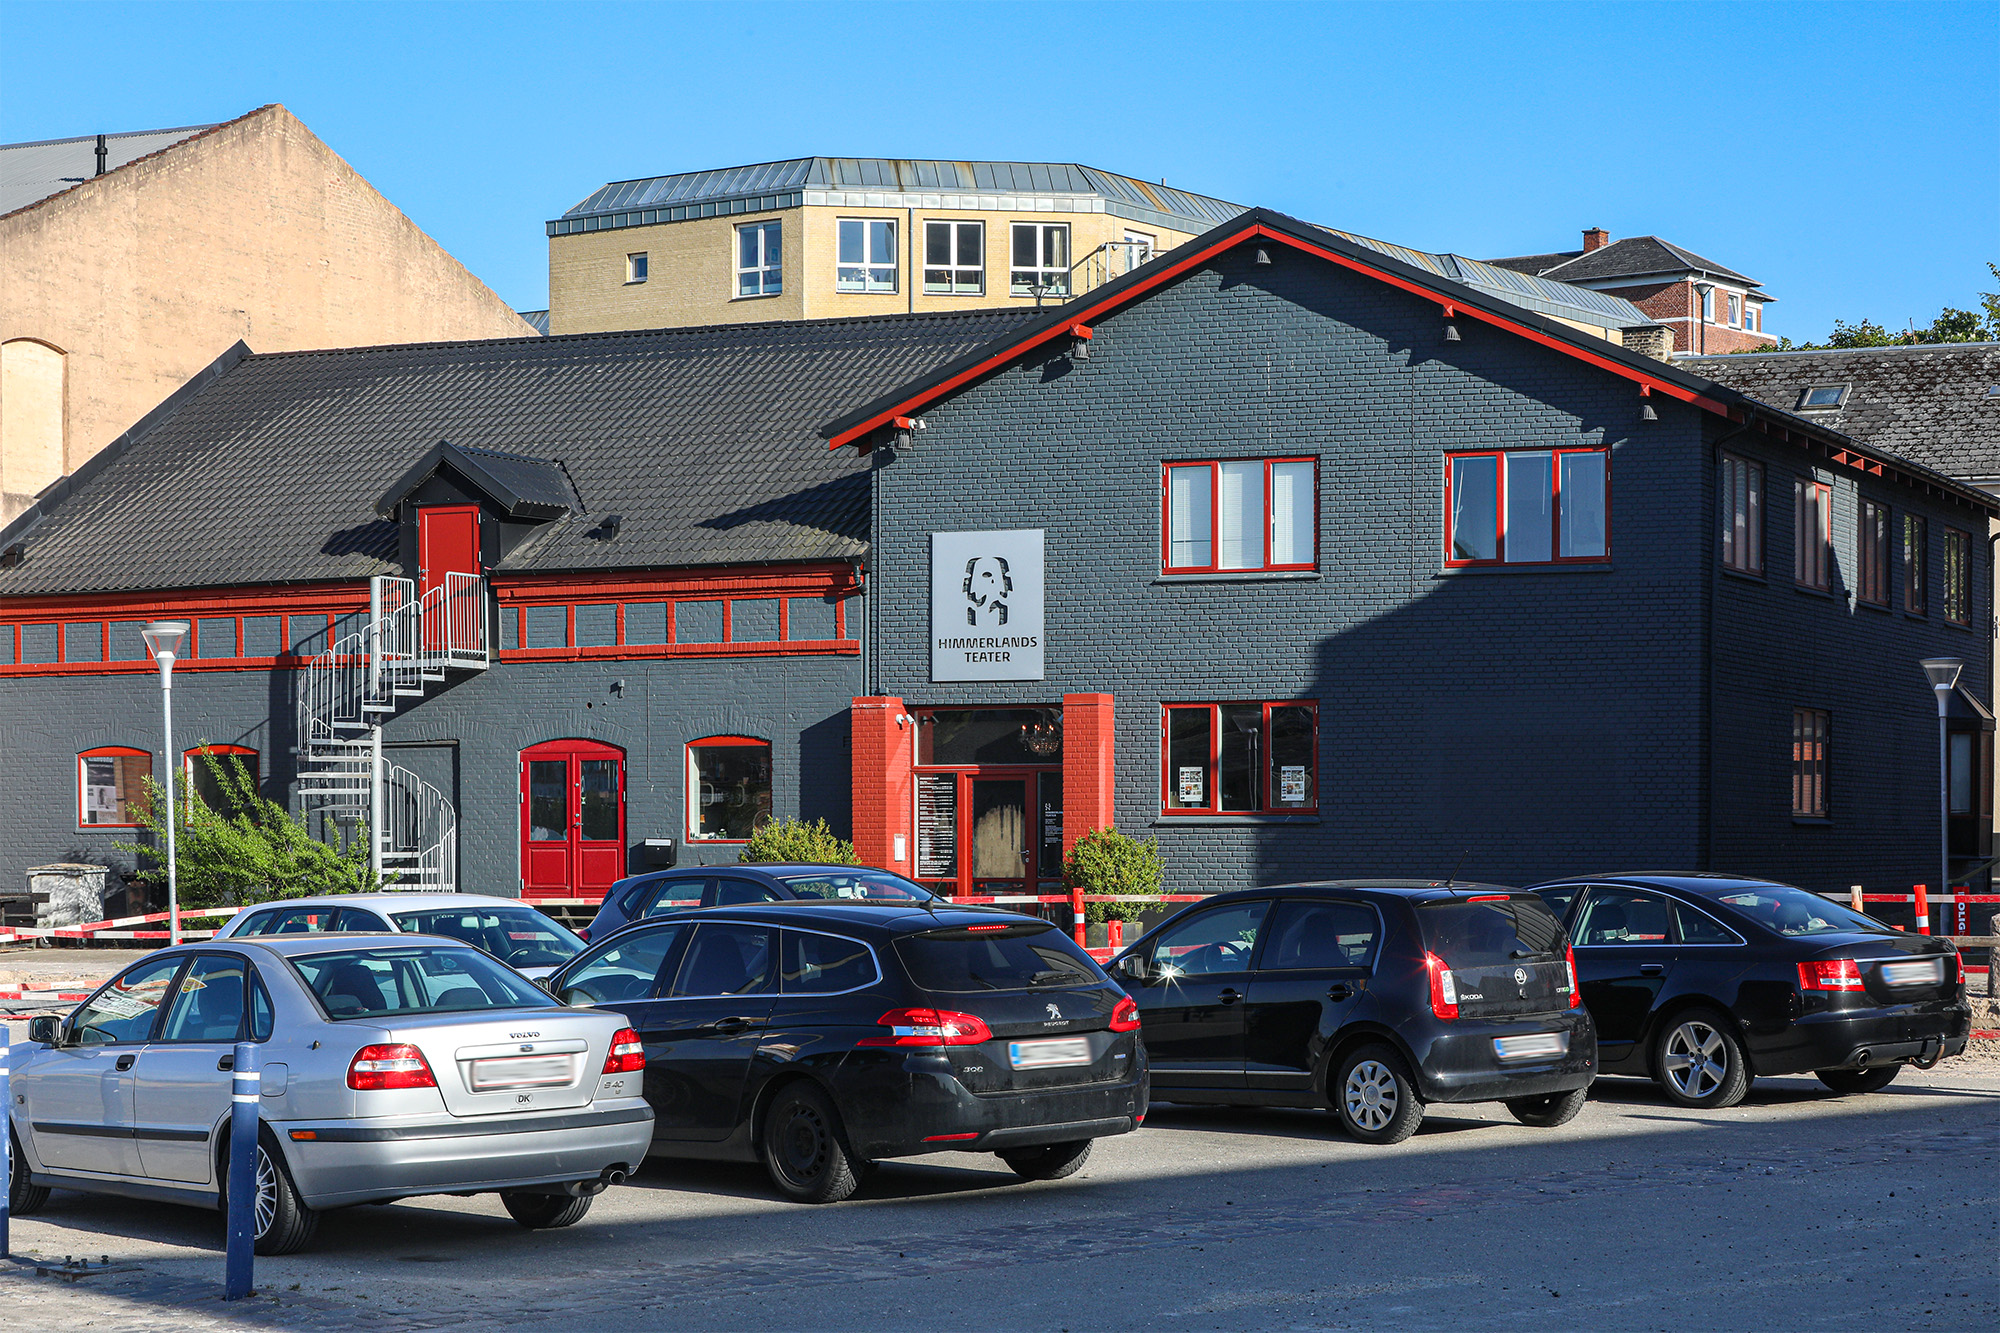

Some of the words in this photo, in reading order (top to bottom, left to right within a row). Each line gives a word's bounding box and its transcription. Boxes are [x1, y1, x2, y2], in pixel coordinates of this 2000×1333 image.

[938, 636, 1038, 649] HIMMERLANDS
[964, 651, 1011, 663] TEATER
[509, 1031, 541, 1039] VOLVO
[518, 1094, 531, 1103] DK
